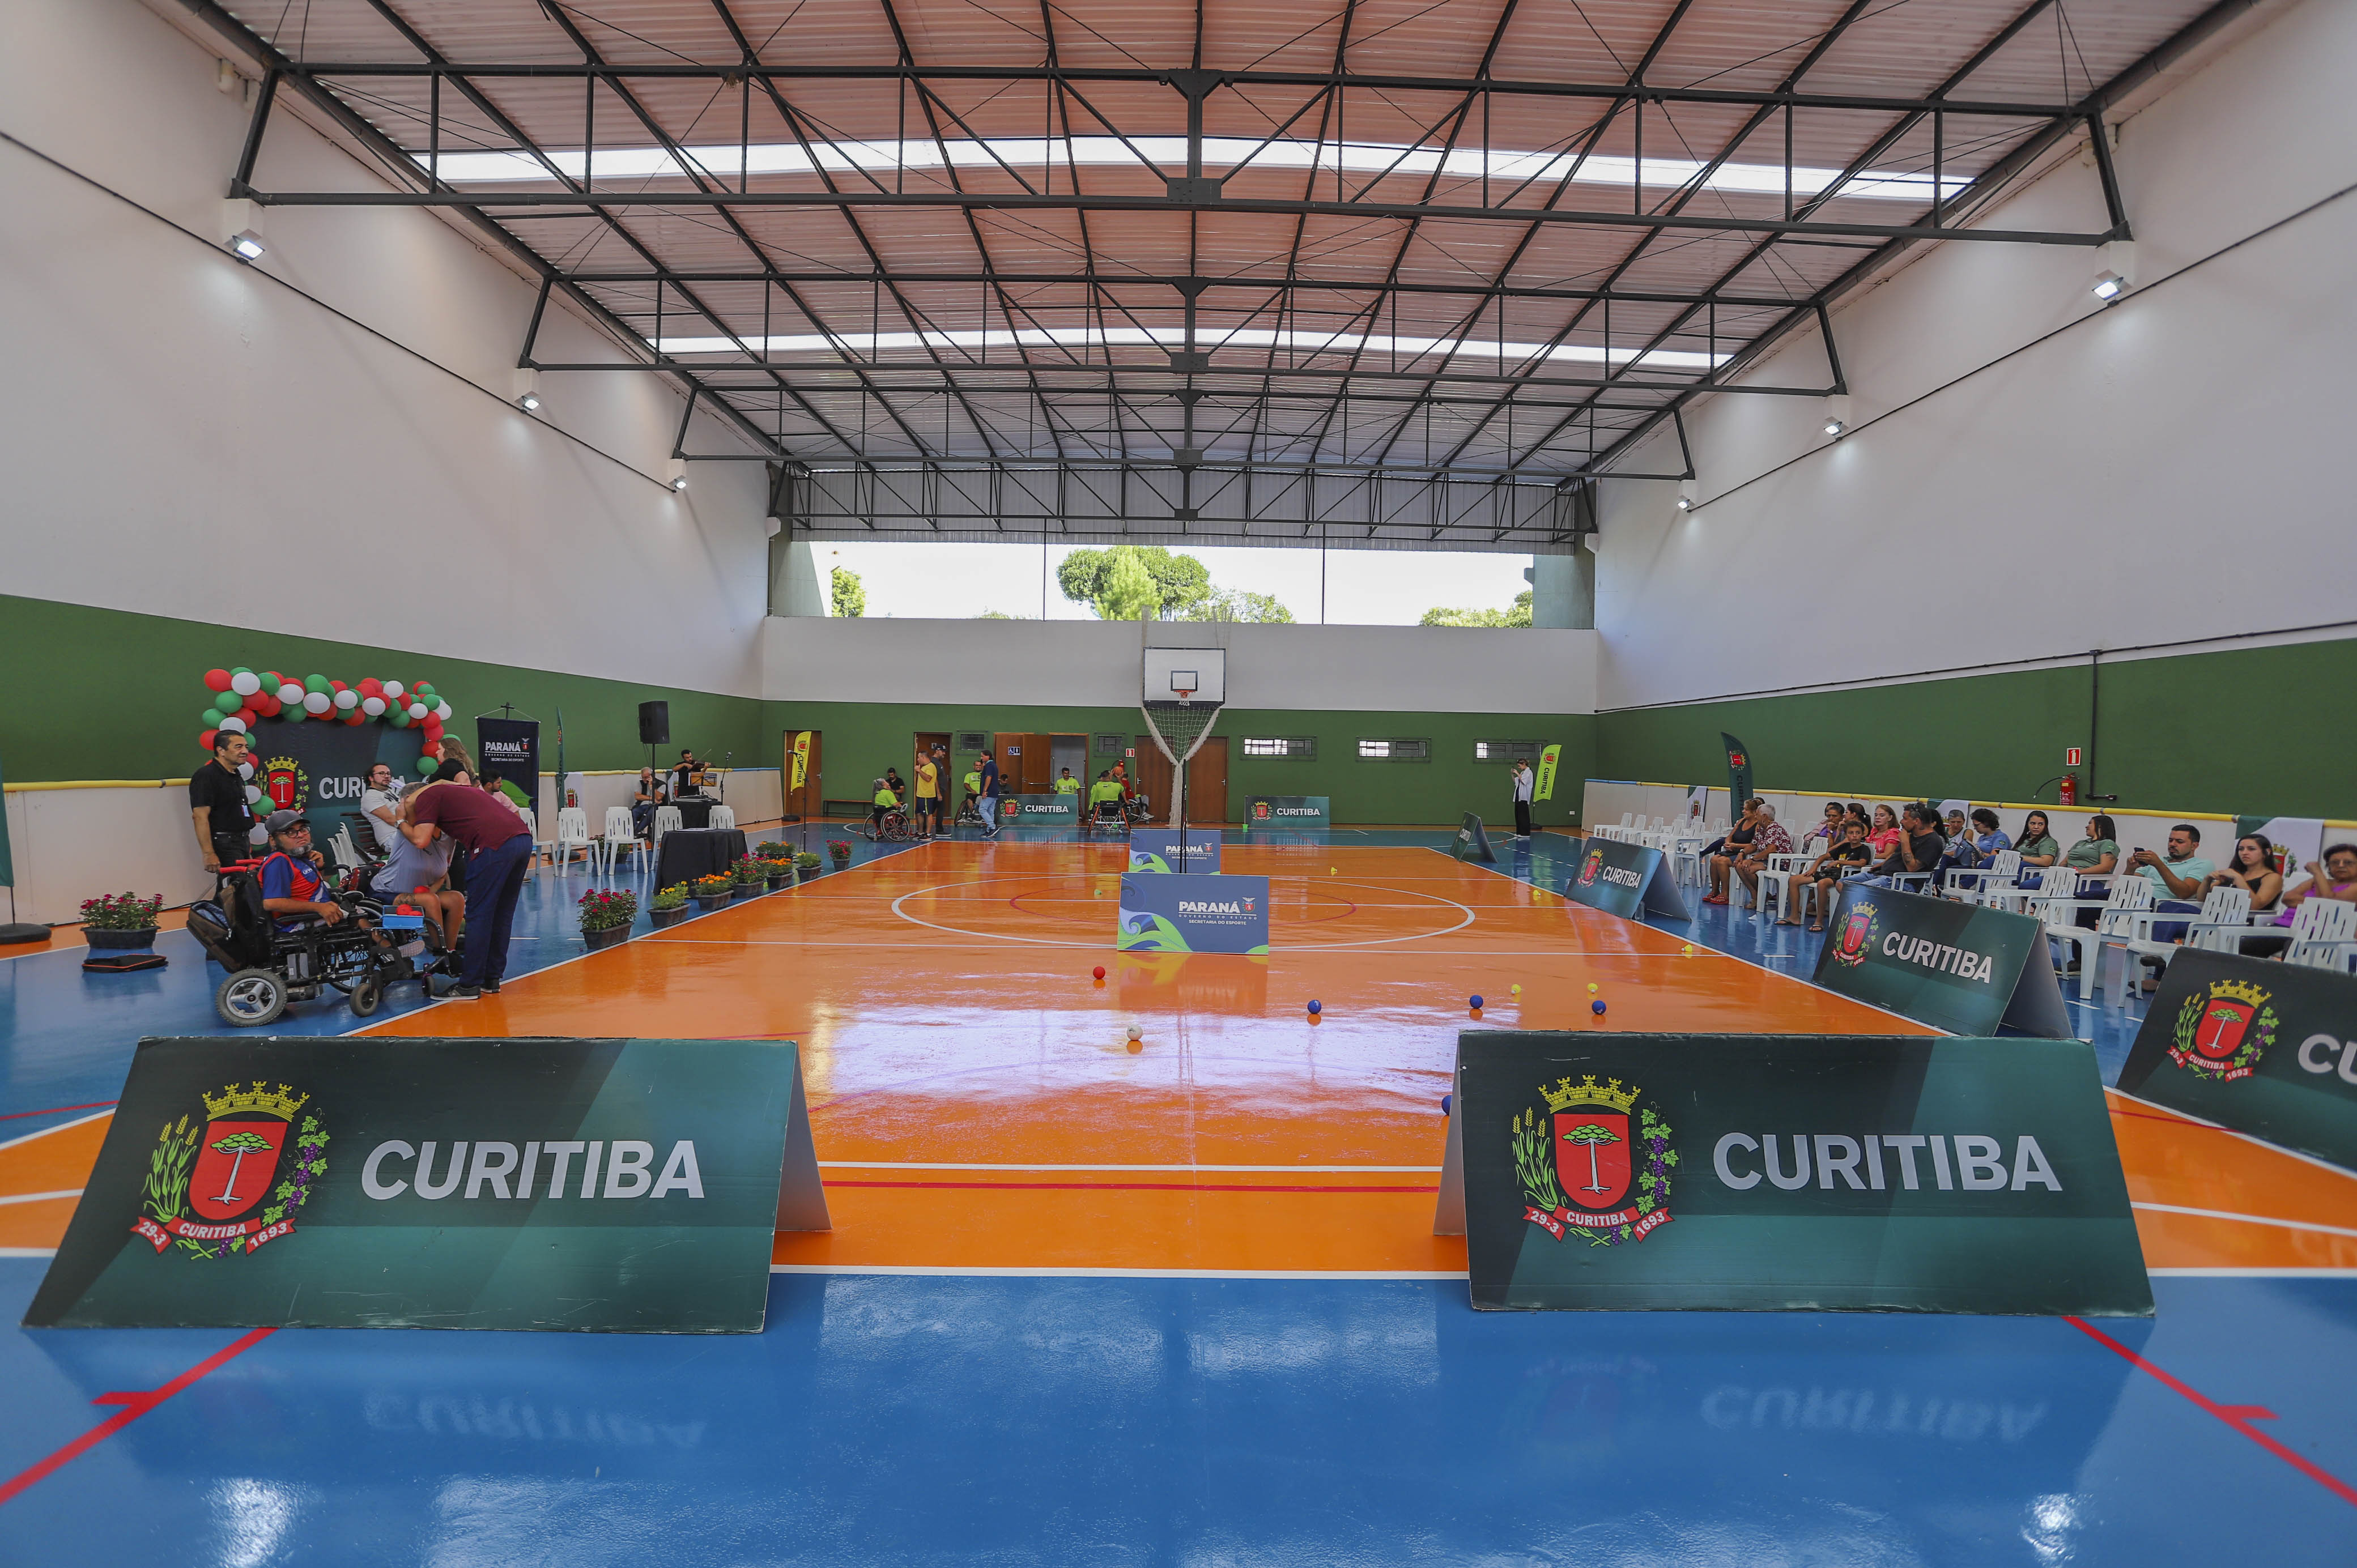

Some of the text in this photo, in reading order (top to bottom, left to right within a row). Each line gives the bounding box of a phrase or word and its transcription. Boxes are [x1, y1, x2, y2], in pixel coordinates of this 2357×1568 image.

[485, 742, 521, 752] PARANÁ
[1540, 768, 1550, 794] CURITIBA
[1603, 866, 1642, 888] CURITIBA
[1178, 901, 1240, 913] PARANÁ
[1883, 932, 1992, 983] CURITIBA
[2169, 1049, 2249, 1080] 29-3 CURITIBA 1693
[361, 1139, 706, 1200] CURITIBA
[1713, 1132, 2063, 1191] CURITIBA
[139, 1221, 287, 1247] 29-3 CURITIBA 1693
[1530, 1211, 1665, 1235] 29-3 CURITIBA 1693
